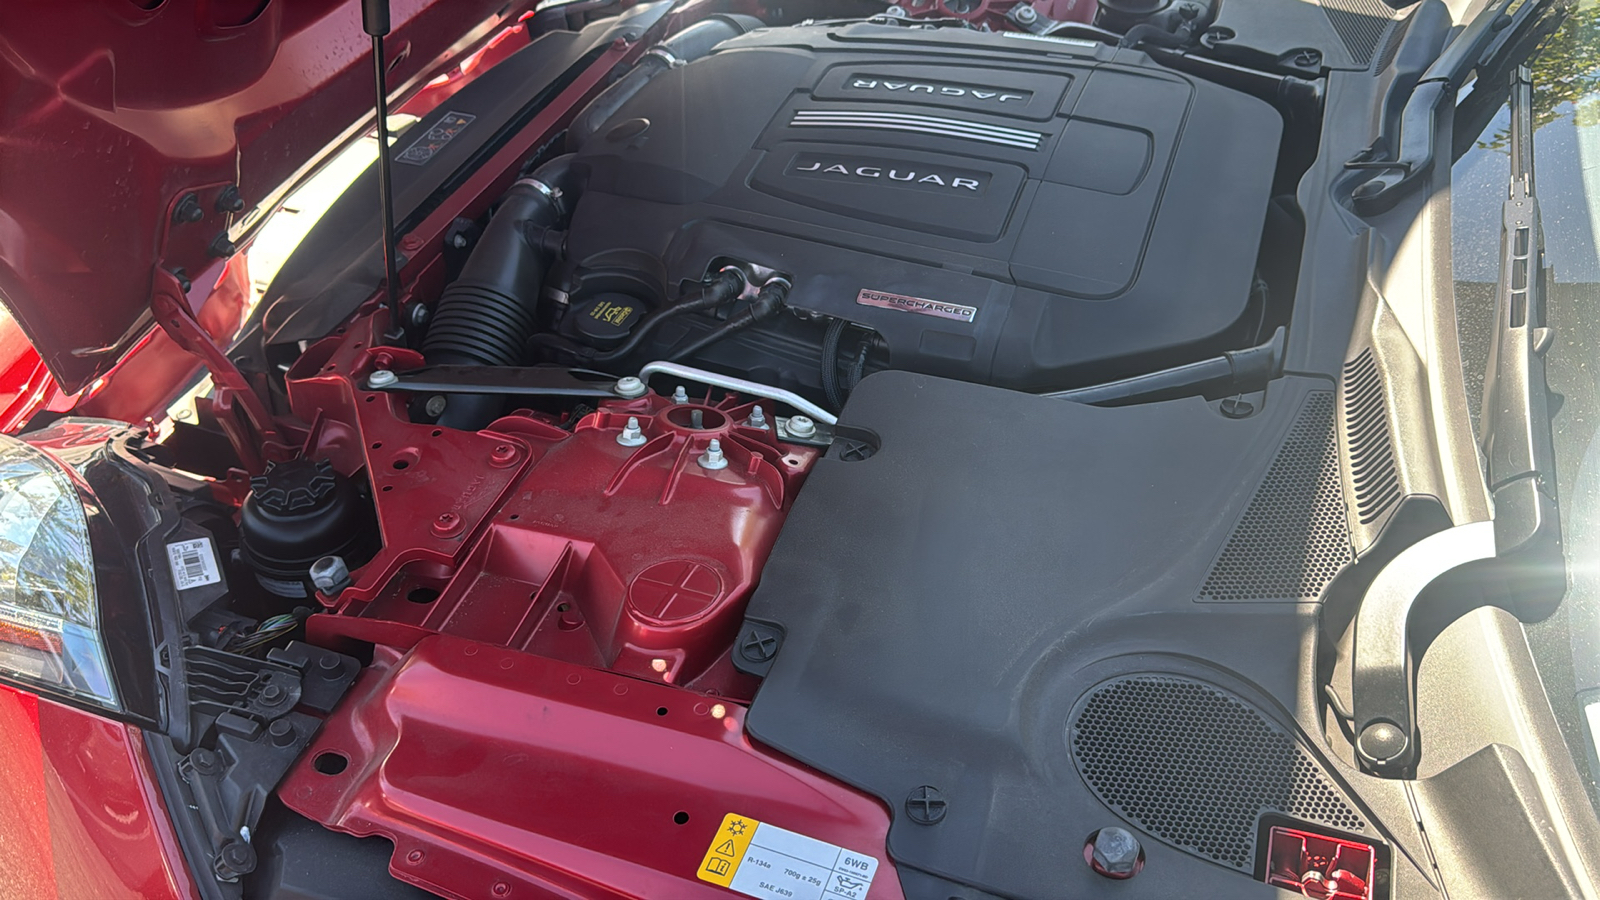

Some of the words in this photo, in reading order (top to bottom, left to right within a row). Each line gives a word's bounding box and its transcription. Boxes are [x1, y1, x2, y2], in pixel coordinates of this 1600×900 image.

[853, 79, 1023, 102] JAGUAR
[796, 162, 980, 191] JAGUAR
[861, 292, 972, 317] SUPERCHARGED
[747, 856, 772, 869] R-134a
[844, 857, 869, 871] 6WB
[784, 868, 801, 880] 700g
[808, 876, 822, 887] 25g
[759, 881, 775, 892] SAE
[775, 887, 793, 898] J639
[834, 886, 857, 898] SP-A2
